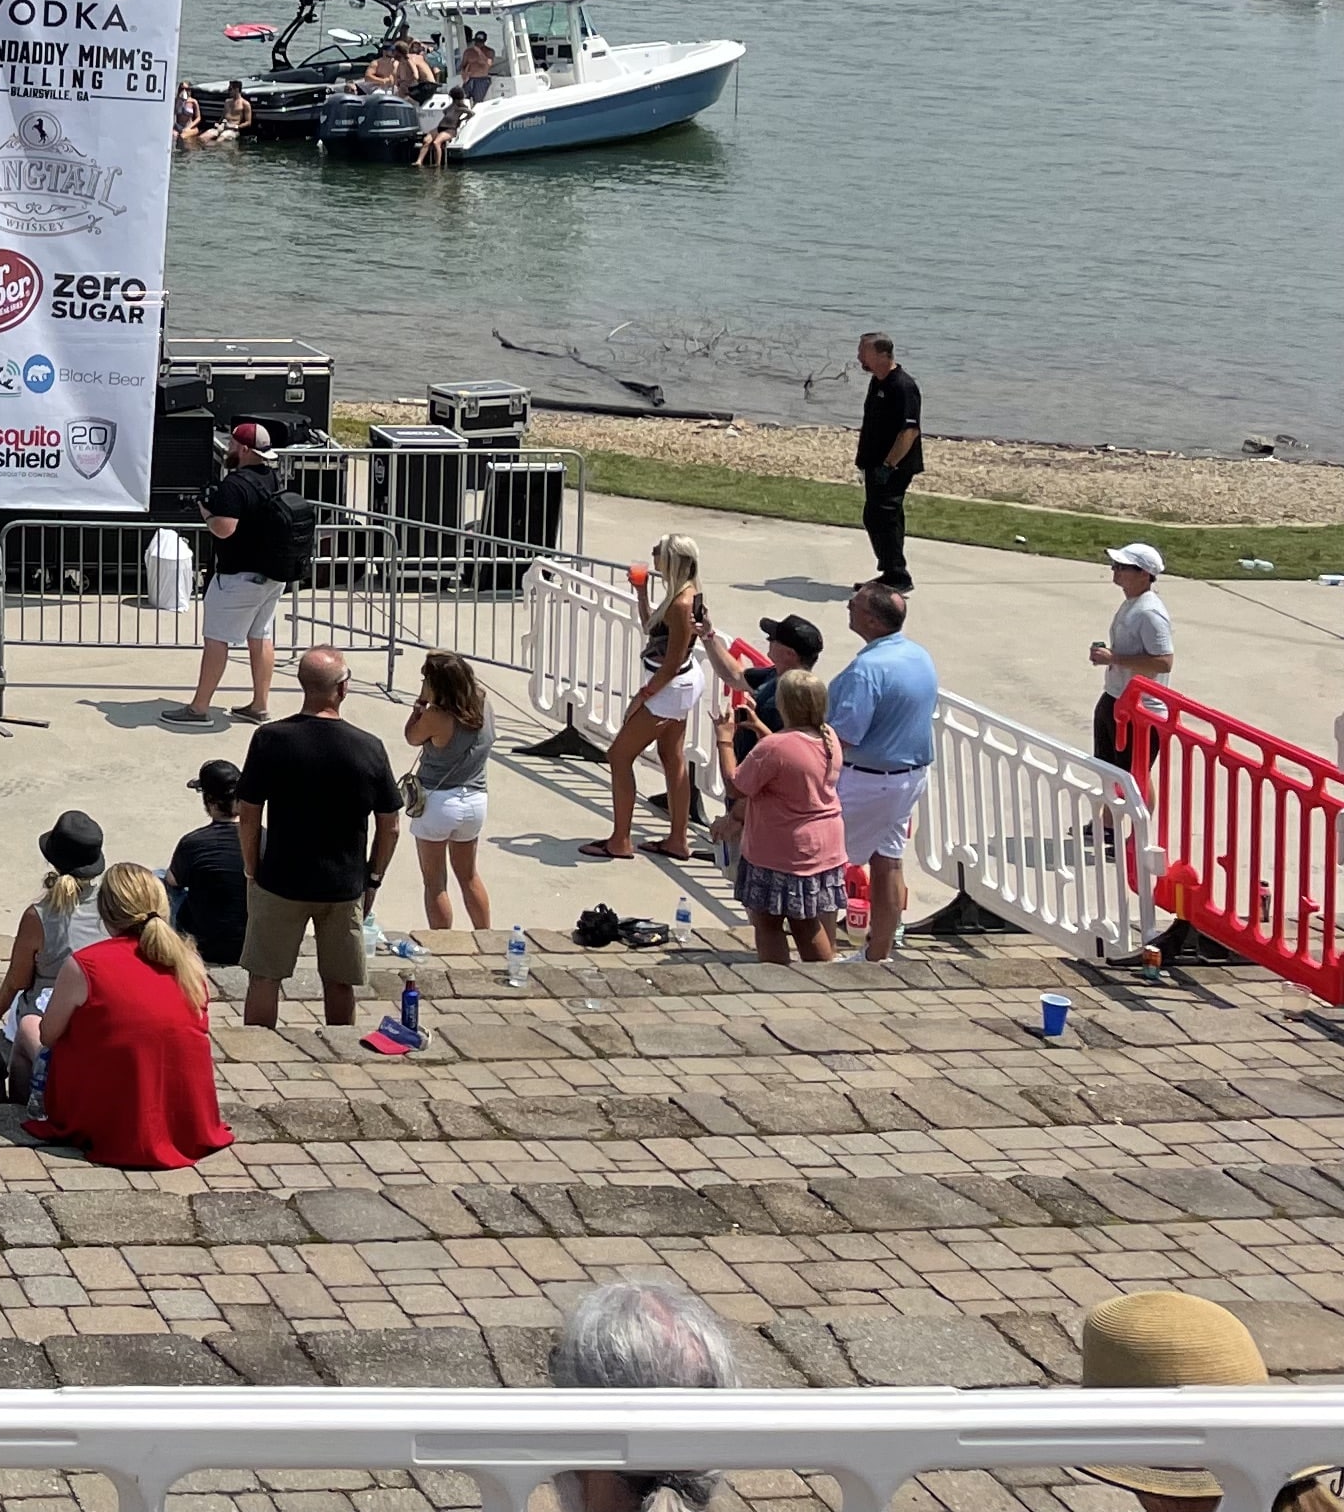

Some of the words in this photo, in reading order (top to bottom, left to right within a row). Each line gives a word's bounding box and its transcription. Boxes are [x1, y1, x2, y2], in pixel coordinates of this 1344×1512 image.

[78, 45, 153, 71] MIMM'S
[126, 74, 162, 94] CO.
[10, 87, 72, 101] BLAIRSVILLE,
[76, 91, 90, 102] GA
[5, 218, 66, 233] WHISKEY
[52, 272, 146, 303] zero
[51, 300, 145, 325] SUGAR
[59, 368, 103, 385] Black
[108, 371, 146, 387] Bear
[71, 426, 108, 446] 20
